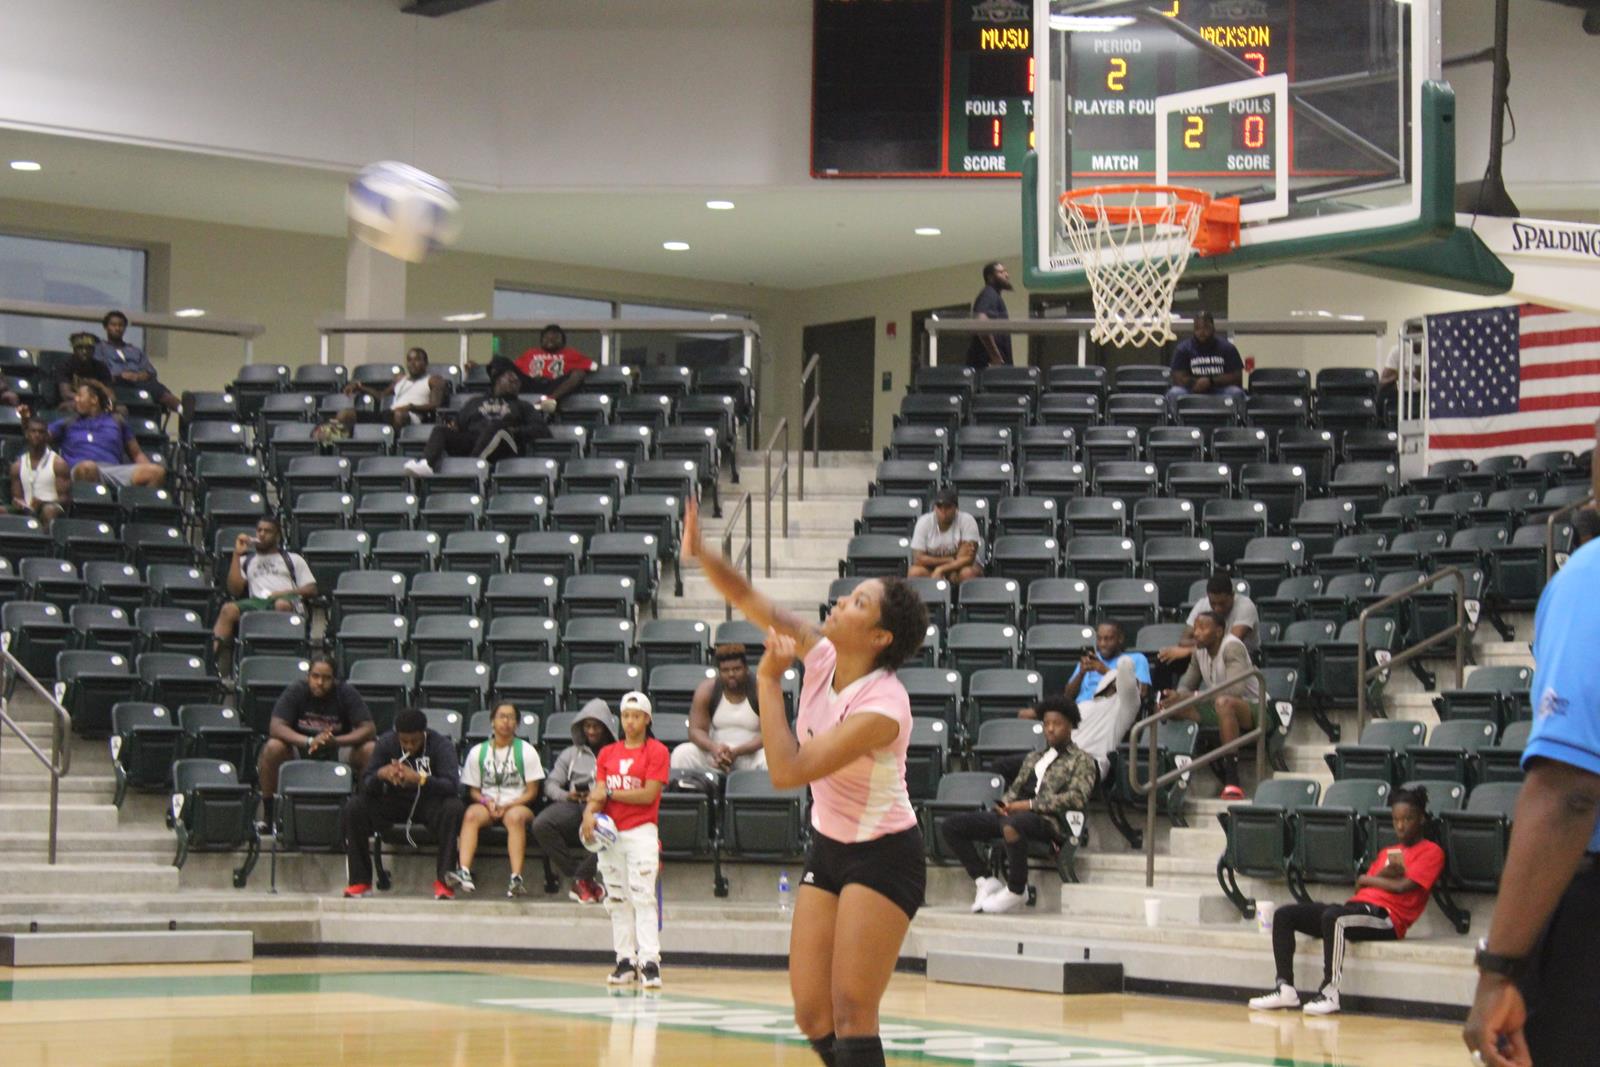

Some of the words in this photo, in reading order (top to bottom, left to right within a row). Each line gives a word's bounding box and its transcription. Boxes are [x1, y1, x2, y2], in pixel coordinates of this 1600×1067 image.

[1094, 38, 1142, 54] PERIOD
[1107, 57, 1127, 91] 2
[965, 100, 1007, 115] FOULS
[1074, 99, 1125, 115] PLAYER
[1128, 99, 1156, 115] FOU
[1229, 98, 1271, 113] FOULS
[1184, 116, 1204, 149] 2
[1244, 115, 1264, 148] 0
[963, 156, 1006, 171] SCORE
[1092, 155, 1139, 170] MATCH
[1227, 155, 1270, 170] SCORE
[1512, 222, 1600, 256] SPALDING
